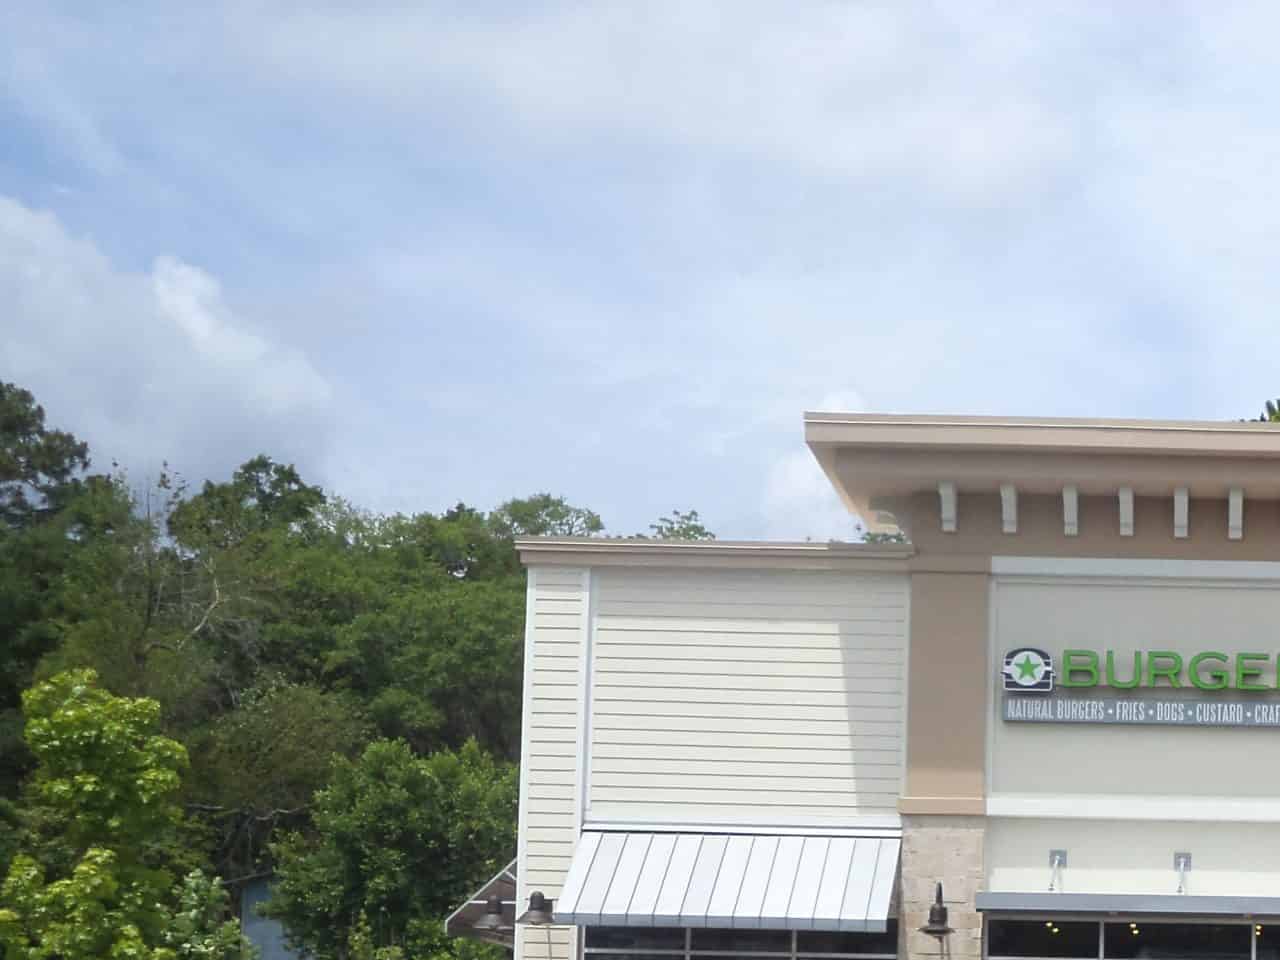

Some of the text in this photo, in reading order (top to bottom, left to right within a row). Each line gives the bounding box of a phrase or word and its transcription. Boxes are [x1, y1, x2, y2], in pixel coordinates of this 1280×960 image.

[1006, 698, 1054, 720] NATURAL
[1056, 699, 1105, 720] BURGERS
[1115, 701, 1146, 721] FRIES
[1156, 702, 1185, 721] DOGS
[1195, 703, 1244, 723] CUSTARD
